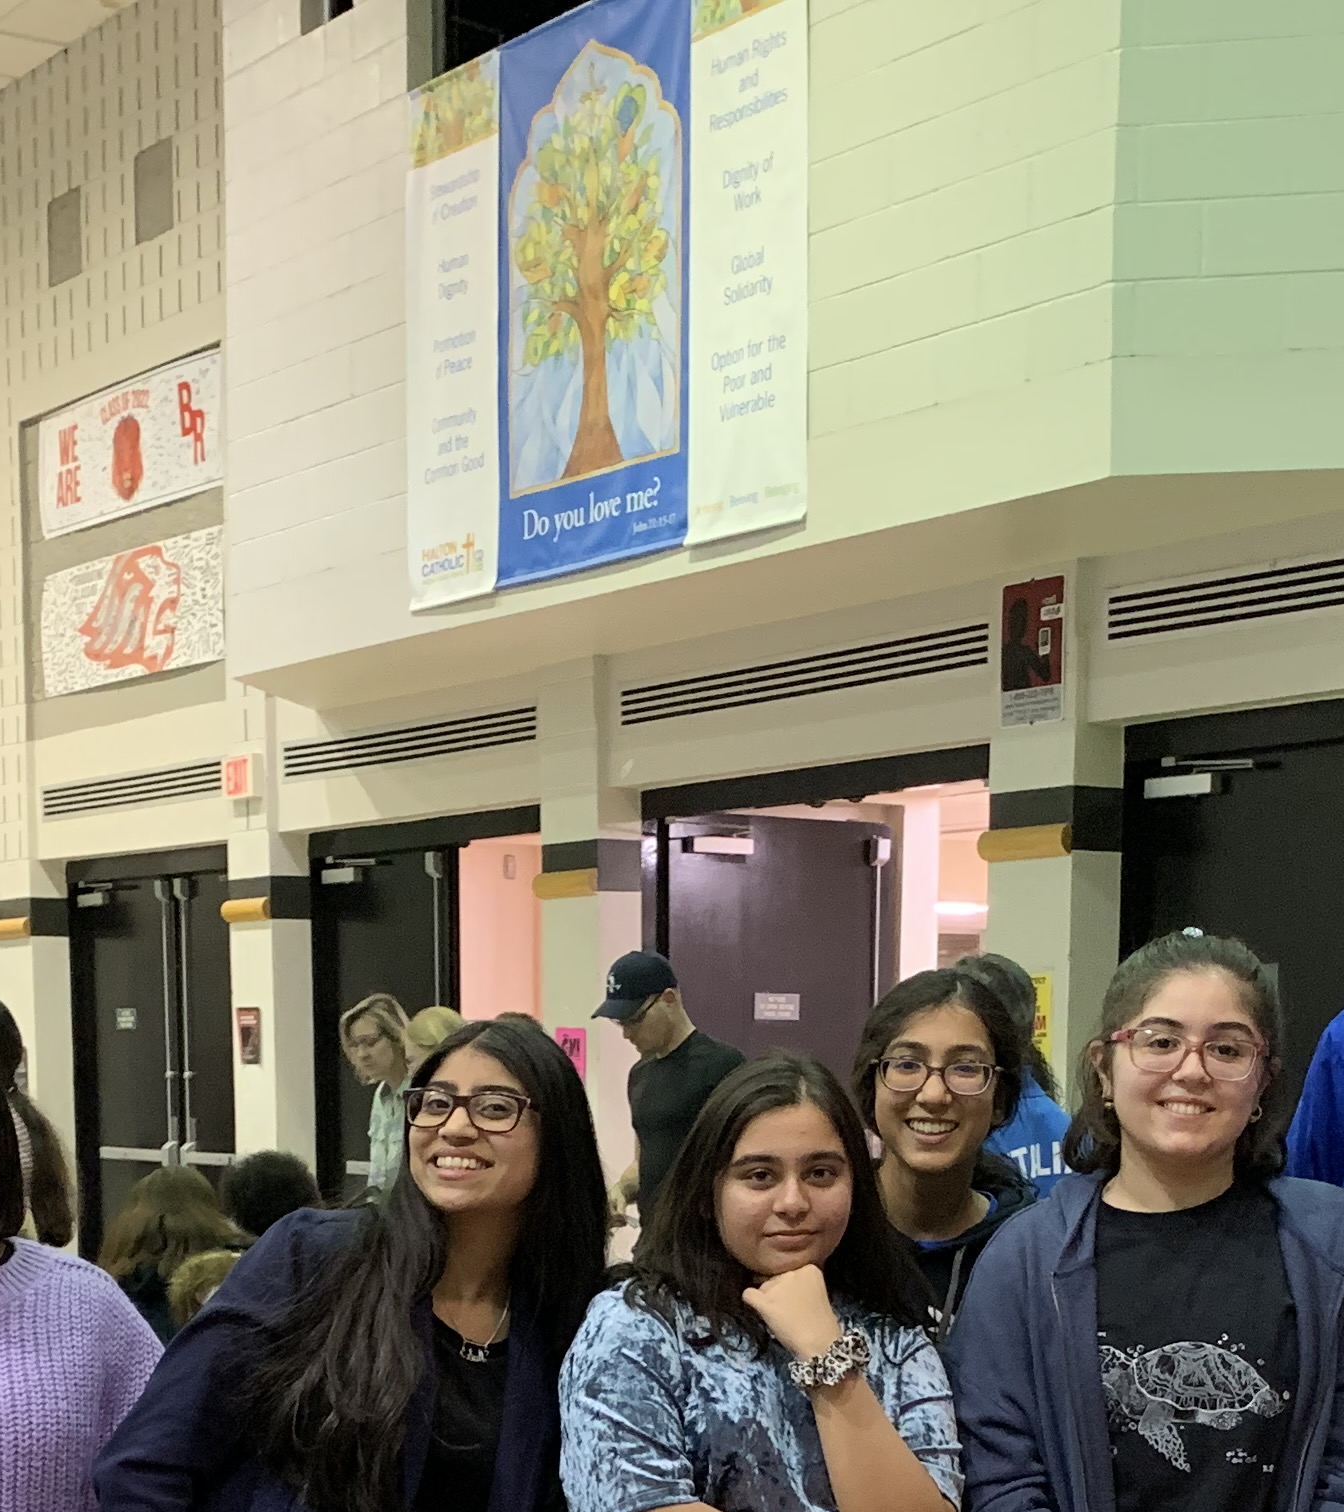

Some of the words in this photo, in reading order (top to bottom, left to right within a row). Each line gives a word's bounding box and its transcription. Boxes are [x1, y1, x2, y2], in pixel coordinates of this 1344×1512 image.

[710, 48, 750, 77] Human
[752, 30, 788, 60] Rights
[738, 68, 759, 94] and
[722, 161, 760, 189] Dignity
[762, 150, 775, 174] of
[733, 185, 762, 212] Work
[730, 245, 765, 275] Global
[723, 274, 774, 306] Solidarity
[443, 356, 473, 377] Peace
[711, 346, 745, 372] Option
[747, 338, 763, 360] for
[767, 333, 787, 353] the
[722, 372, 747, 394] Poor
[750, 361, 773, 387] and
[177, 381, 206, 465] BR
[719, 390, 776, 424] Vulnerable
[58, 423, 78, 467] WE
[461, 451, 485, 474] Good
[56, 463, 82, 509] ARE
[522, 508, 550, 541] Do
[553, 511, 586, 543] you
[589, 491, 622, 525] love
[625, 476, 662, 519] me?
